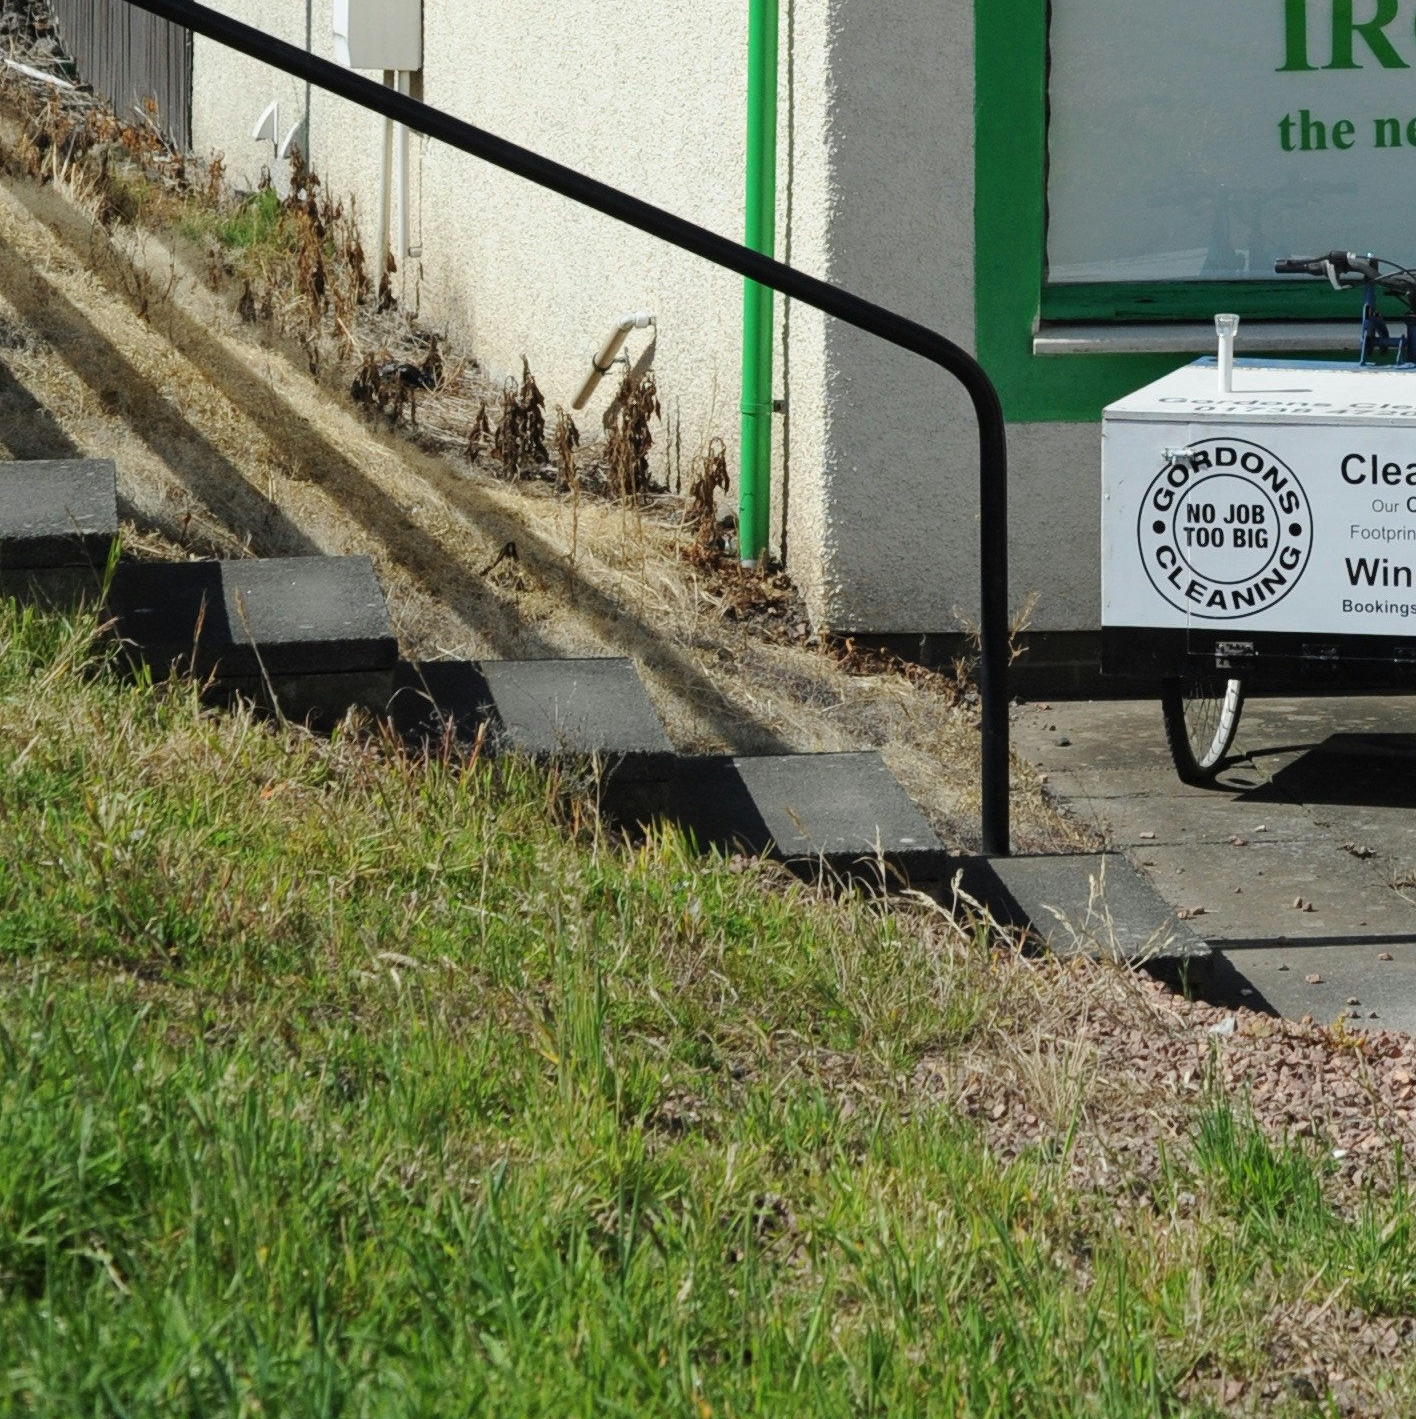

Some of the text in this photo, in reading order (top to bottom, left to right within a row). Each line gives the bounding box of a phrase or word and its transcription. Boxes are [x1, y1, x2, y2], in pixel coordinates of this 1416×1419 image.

[1277, 107, 1358, 154] the
[1158, 397, 1333, 408] Gordons
[1194, 405, 1313, 413] 01738
[1152, 447, 1301, 515] GORDONS
[1187, 503, 1265, 525] NO JOB
[1372, 499, 1400, 513] Our
[1183, 527, 1269, 549] TOO BIG
[1155, 545, 1303, 611] CLEANING
